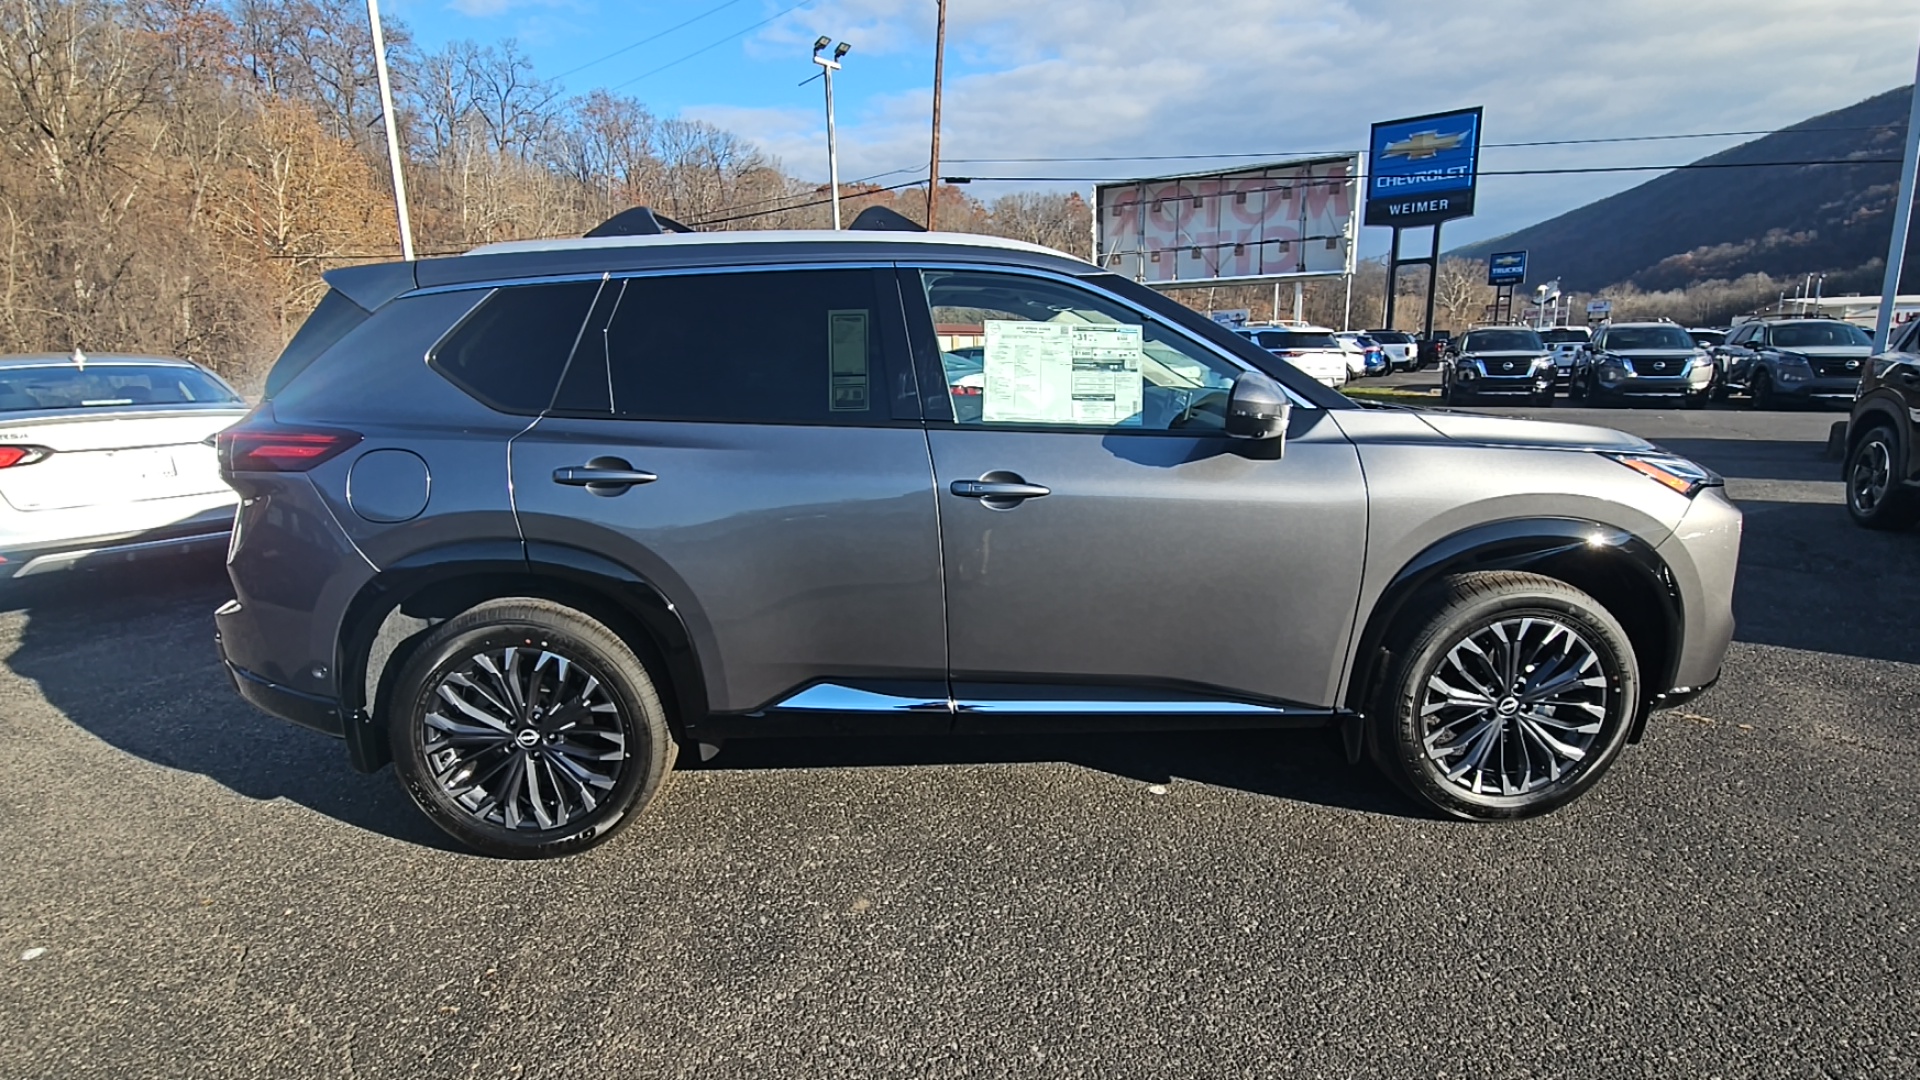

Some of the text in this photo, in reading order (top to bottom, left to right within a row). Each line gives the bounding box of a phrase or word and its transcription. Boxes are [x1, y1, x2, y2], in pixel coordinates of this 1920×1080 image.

[1377, 165, 1468, 188] CHEVROLET
[1389, 199, 1449, 216] WEIMER
[1492, 266, 1523, 274] TRUCKS
